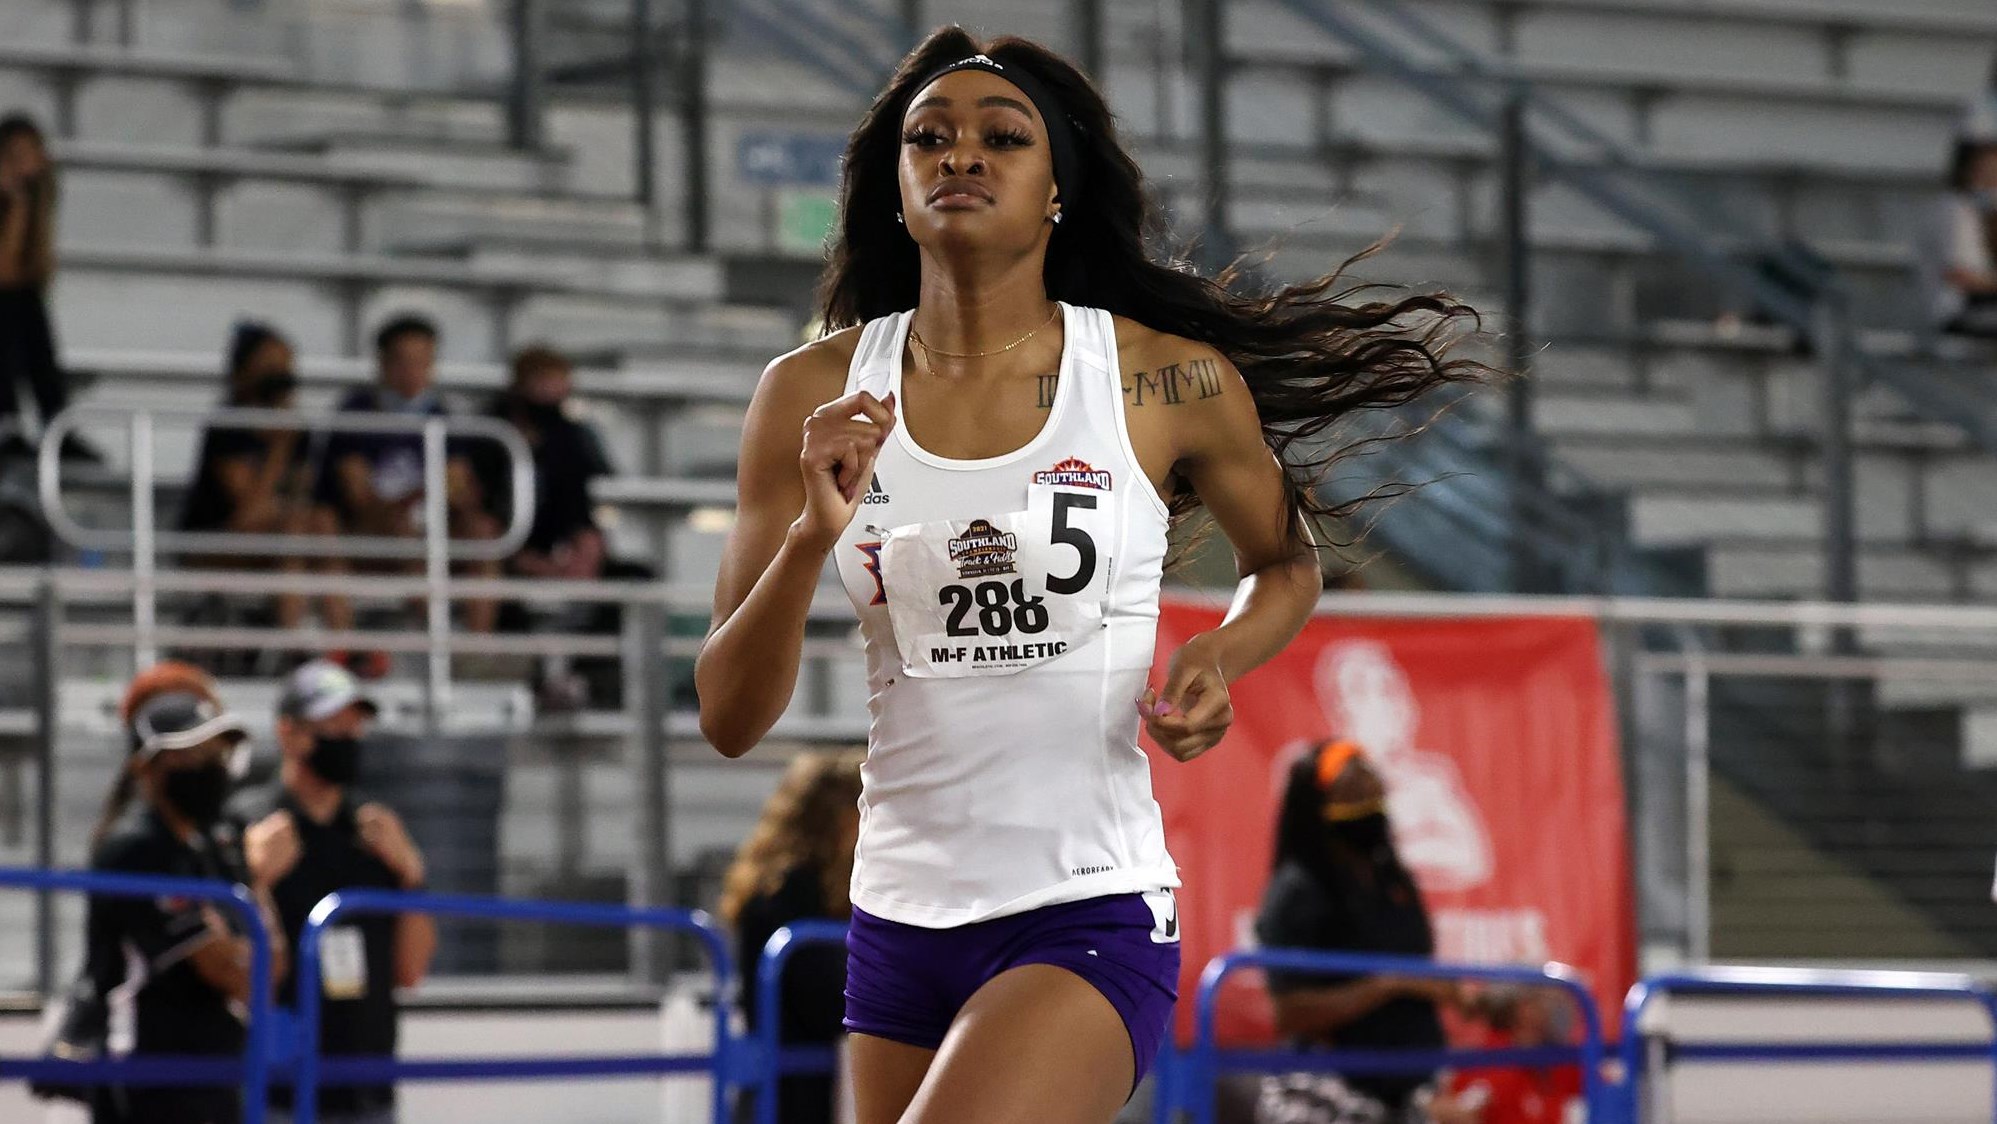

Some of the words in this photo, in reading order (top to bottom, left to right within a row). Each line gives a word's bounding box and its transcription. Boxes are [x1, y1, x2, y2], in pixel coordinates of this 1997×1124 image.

[1036, 471, 1110, 491] SOUTHLAND
[949, 533, 1016, 558] SOUTHLAND
[1045, 491, 1097, 595] 5
[959, 555, 982, 567] Track
[938, 577, 1049, 637] 288
[931, 648, 967, 662] M-F
[973, 641, 1067, 662] ATHLETIC
